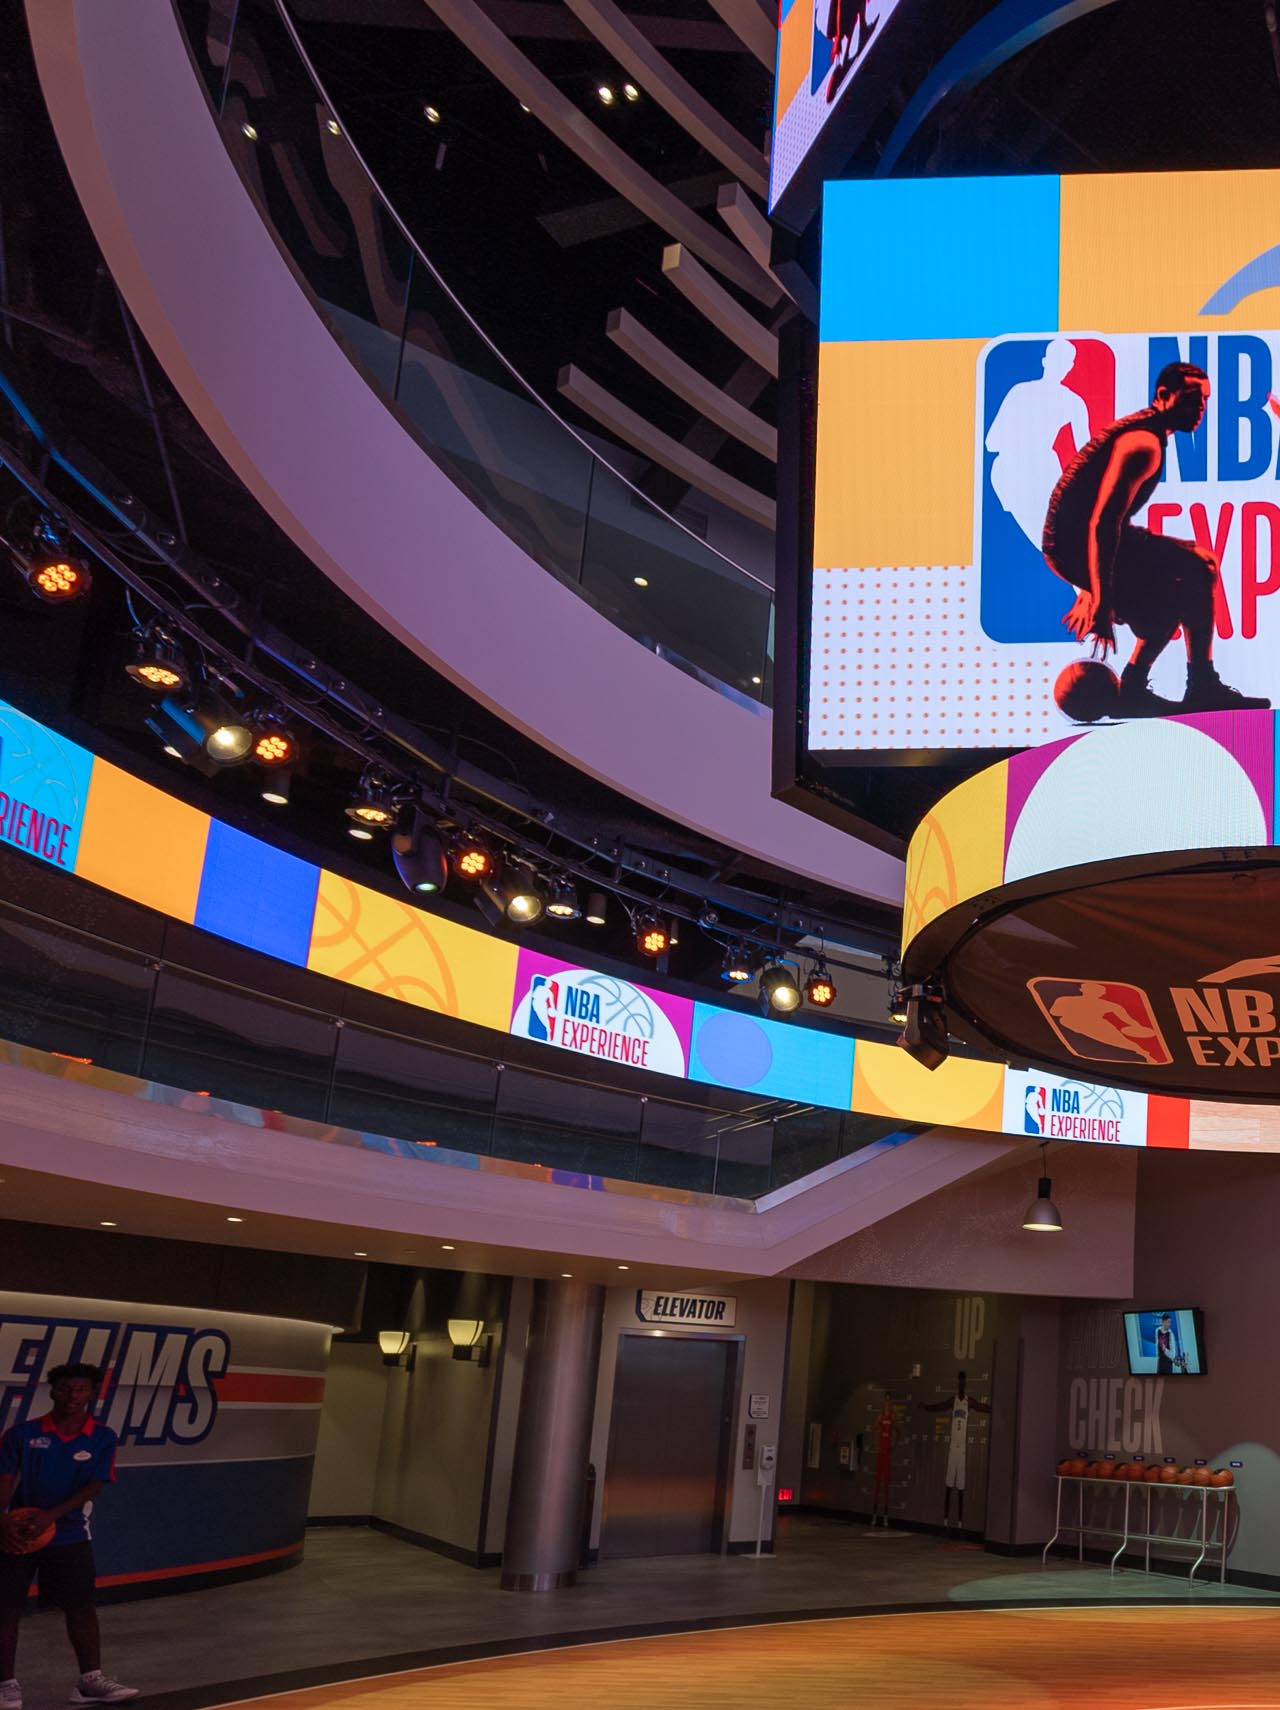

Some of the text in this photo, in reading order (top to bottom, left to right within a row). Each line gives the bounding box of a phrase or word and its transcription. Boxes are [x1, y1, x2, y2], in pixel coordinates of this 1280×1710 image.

[565, 986, 600, 1024] NBA
[561, 1019, 650, 1067] EXPERIENCE
[1051, 1088, 1080, 1115] NBA
[1050, 1114, 1121, 1142] EXPERIENCE
[653, 1296, 726, 1320] ELEVATOR
[954, 1297, 985, 1360] UP
[1069, 1377, 1165, 1454] CHECK
[777, 1487, 793, 1501] EXIT
